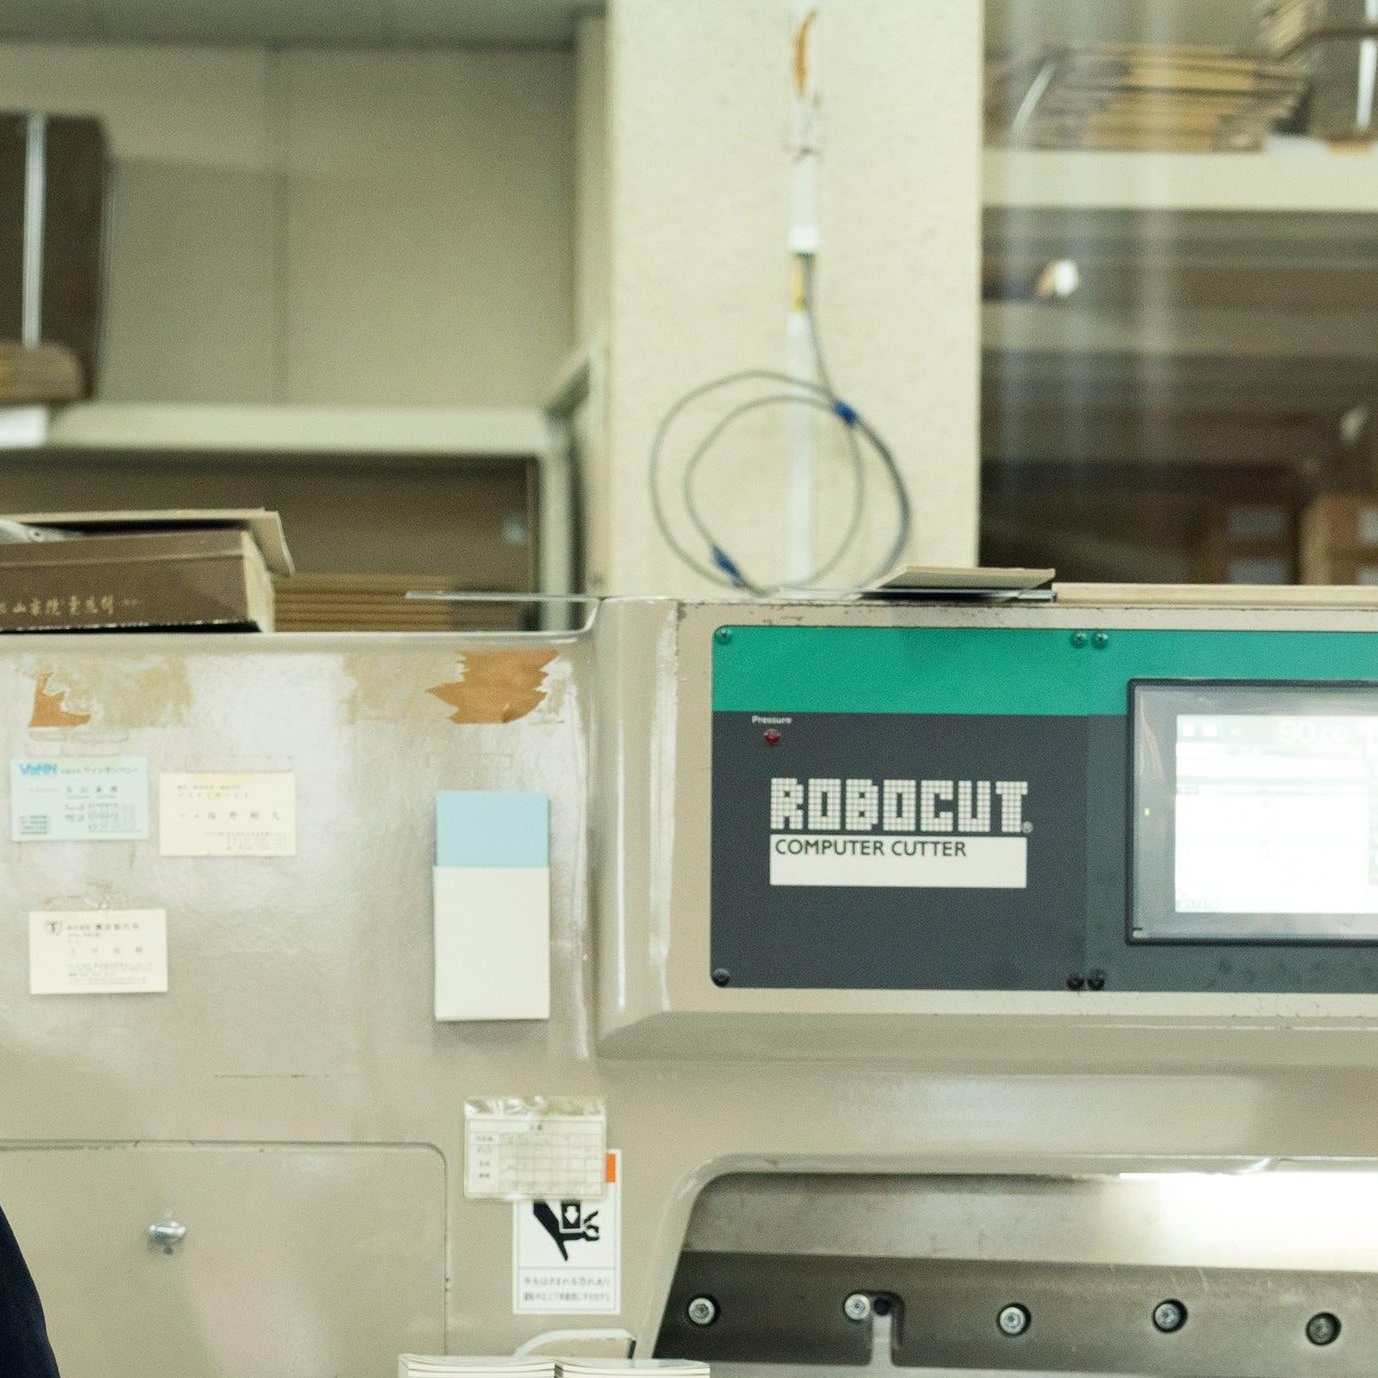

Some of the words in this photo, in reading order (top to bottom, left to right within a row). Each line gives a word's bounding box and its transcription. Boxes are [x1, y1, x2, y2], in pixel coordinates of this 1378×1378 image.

[751, 715, 793, 725] Pressure
[770, 777, 1028, 832] ROBOCUT
[775, 839, 884, 856] COMPUTER
[891, 840, 967, 858] CUTTER
